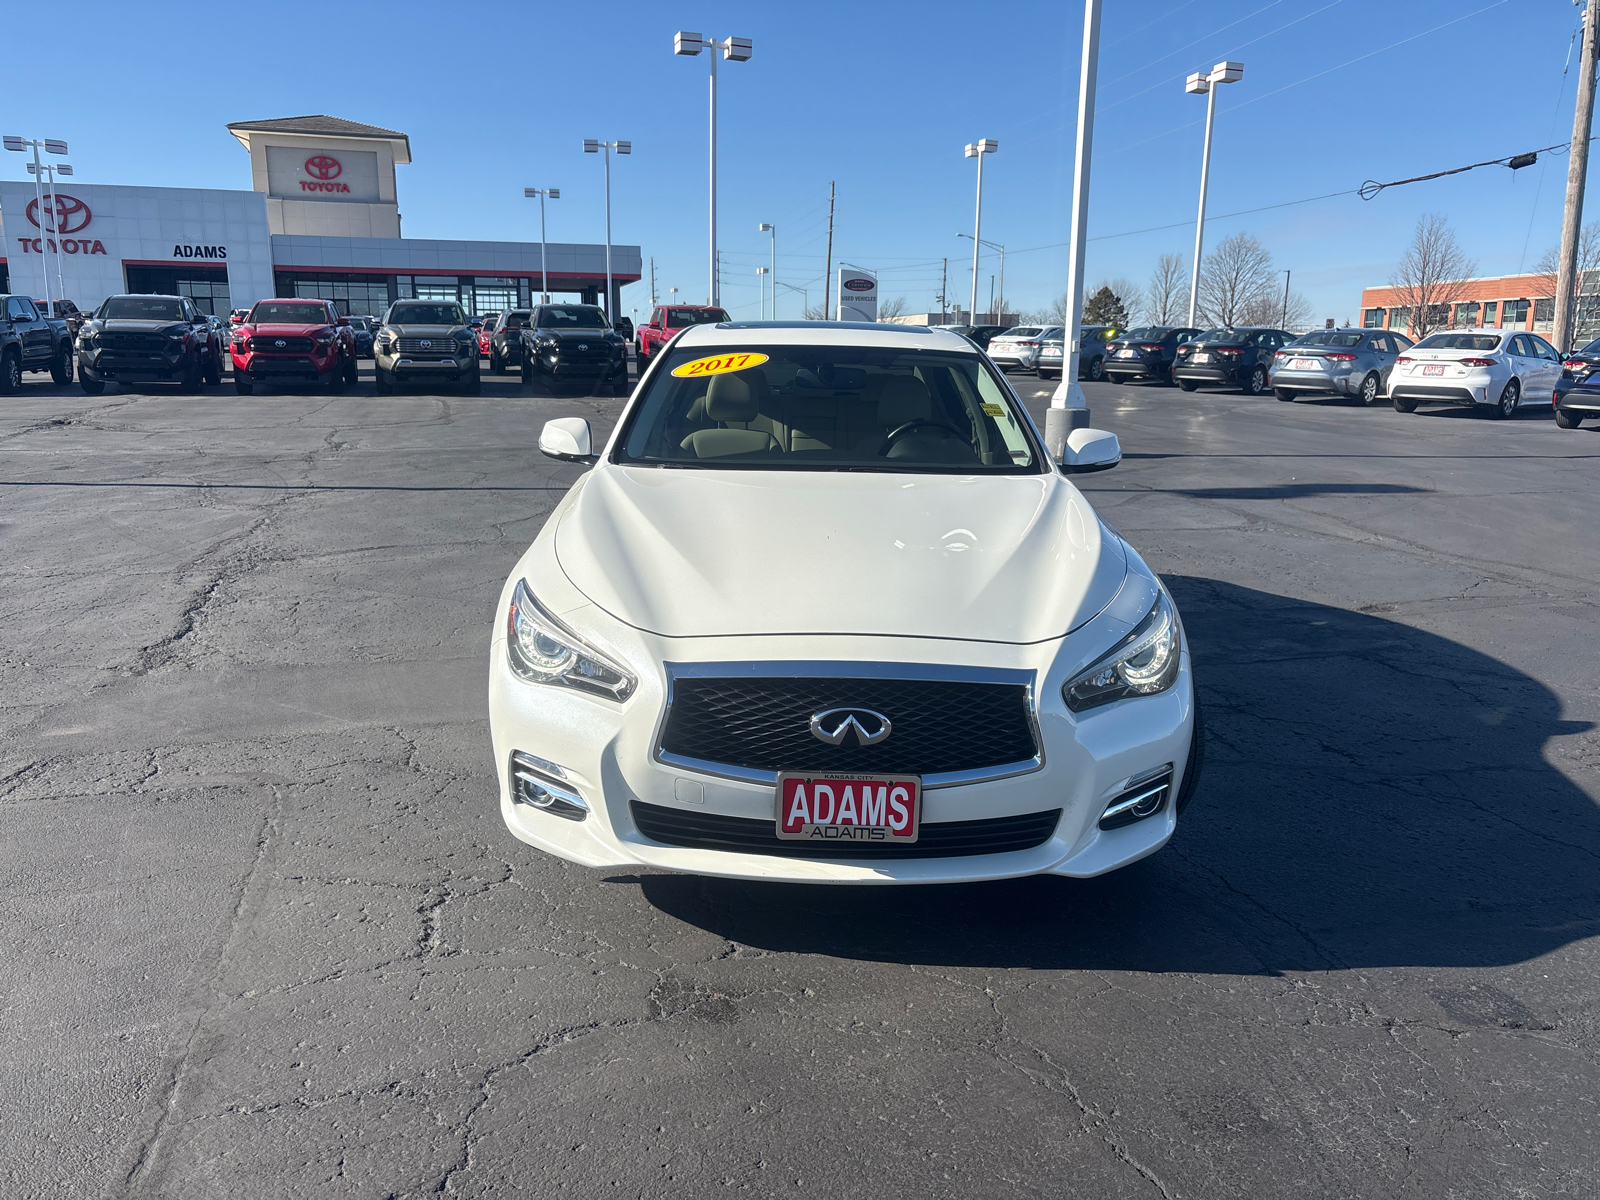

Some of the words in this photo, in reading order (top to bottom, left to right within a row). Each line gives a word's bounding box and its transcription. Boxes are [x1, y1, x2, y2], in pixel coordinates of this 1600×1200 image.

[299, 181, 351, 193] TOYOTA
[17, 238, 107, 255] TOYOTA
[173, 245, 227, 258] ADAMS
[688, 354, 751, 375] 2017
[786, 784, 909, 830] ADAMS
[810, 826, 886, 840] ADAMS
